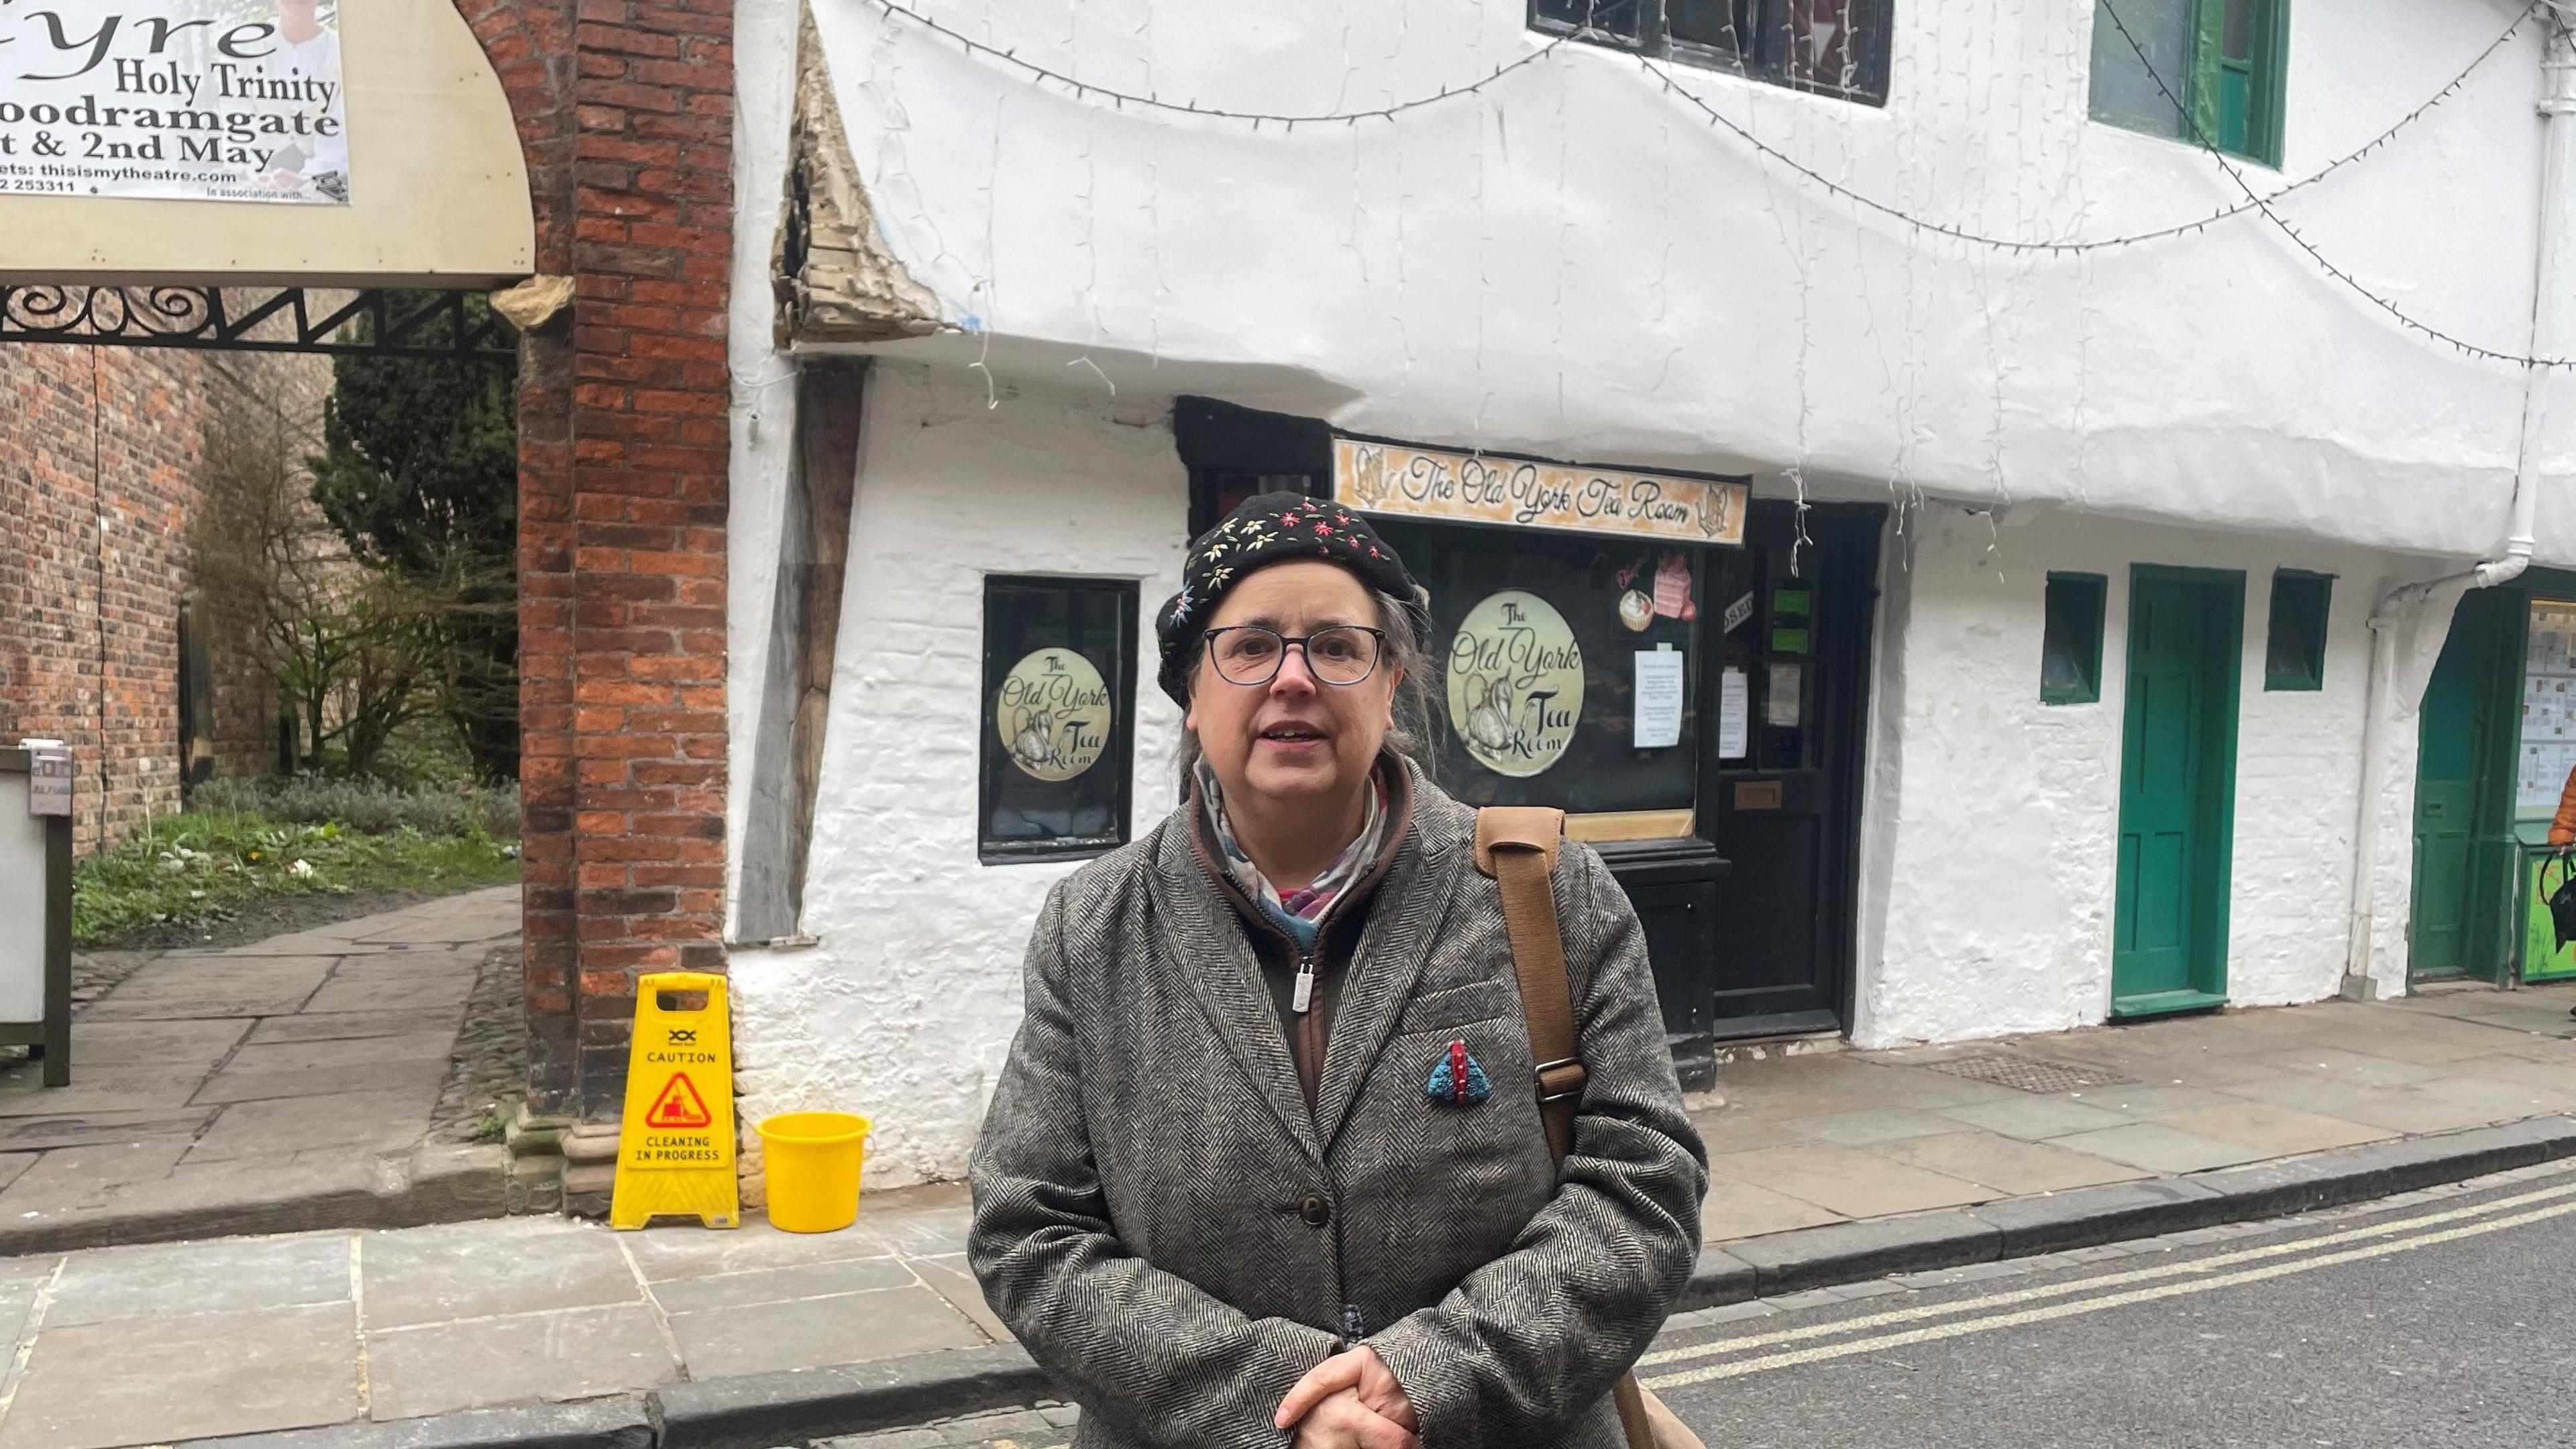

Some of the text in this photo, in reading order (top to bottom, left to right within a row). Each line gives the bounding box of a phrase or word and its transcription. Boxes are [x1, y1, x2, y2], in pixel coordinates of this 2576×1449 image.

[0, 11, 277, 80] yre
[113, 58, 335, 113] Holy Trinity
[32, 130, 66, 156] &
[81, 131, 165, 160] 2nd
[178, 136, 275, 172] May
[15, 179, 74, 191] 253311
[41, 164, 236, 182] thisismytheatre.com
[220, 189, 278, 199] association
[1400, 456, 1688, 523] The Old York Tea Room
[1501, 603, 1525, 625] The
[1045, 657, 1065, 672] The
[1452, 627, 1580, 689] Old York
[1004, 674, 1108, 720] Old York
[1524, 688, 1570, 737] Tea
[1063, 721, 1100, 755] Tea
[1513, 729, 1562, 759] Room
[1050, 747, 1091, 769] Room
[647, 1052, 716, 1063] CAUTION
[647, 1136, 710, 1146] CLEANING
[636, 1150, 719, 1160] IN PROGRESS
